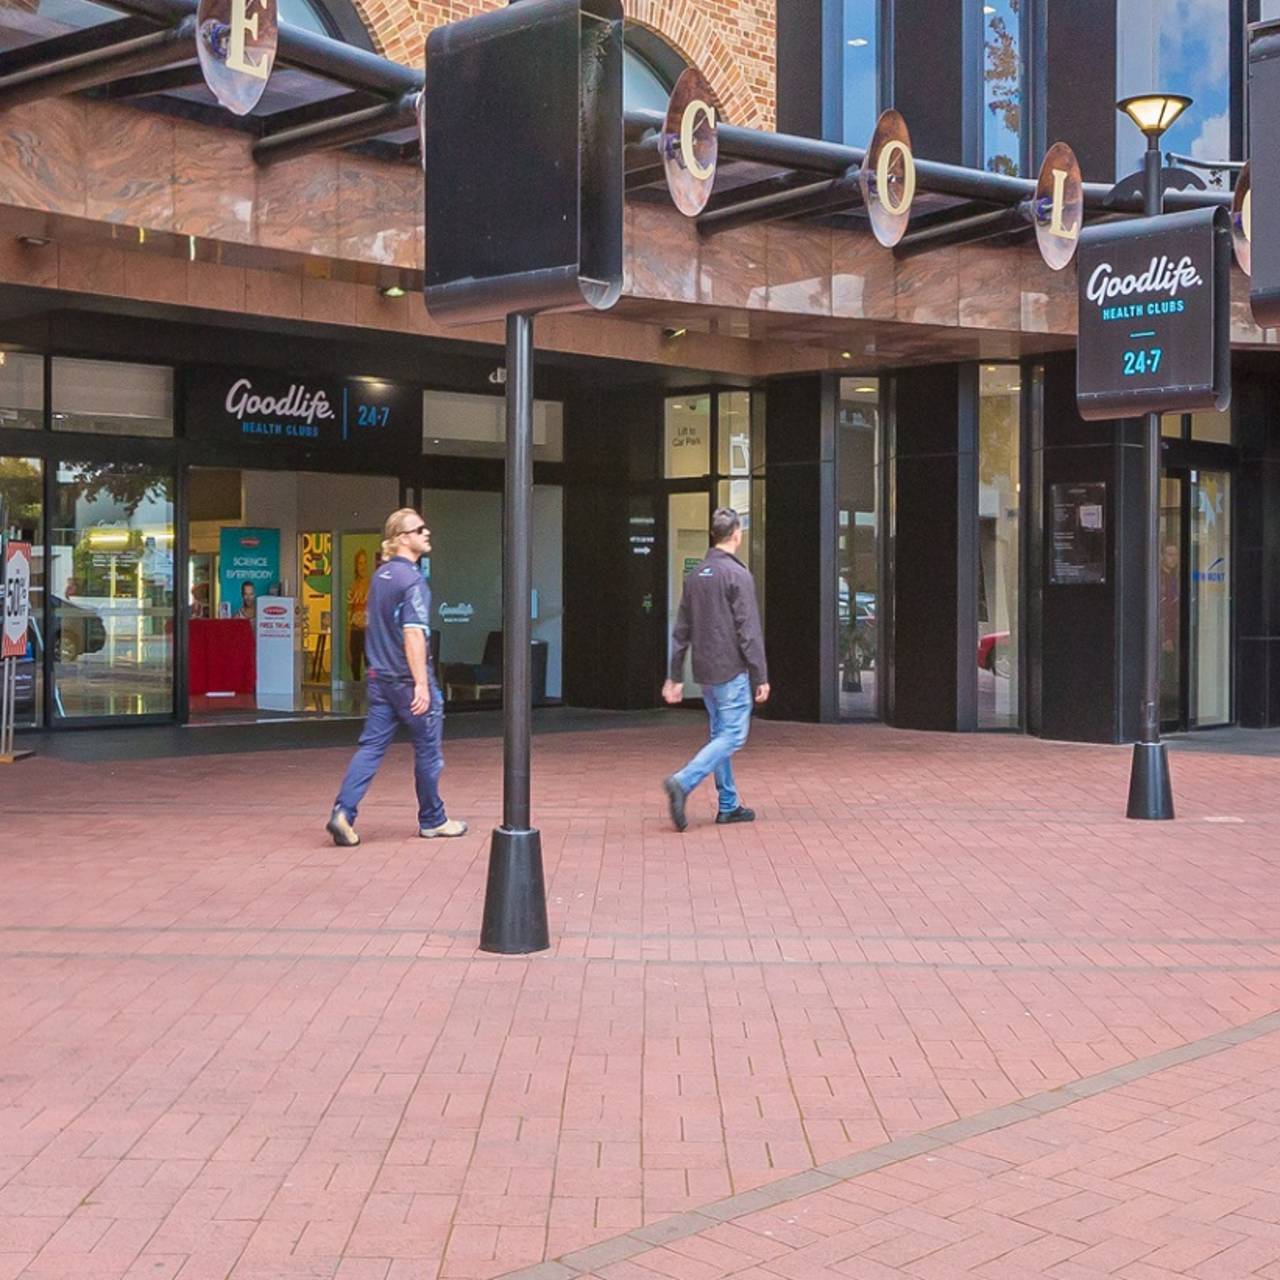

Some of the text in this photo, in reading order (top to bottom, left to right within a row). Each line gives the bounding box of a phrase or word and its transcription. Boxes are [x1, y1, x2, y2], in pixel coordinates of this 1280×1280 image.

[1103, 300, 1185, 321] HEALTH CLUBS
[242, 421, 320, 437] HEALTH CLUBS
